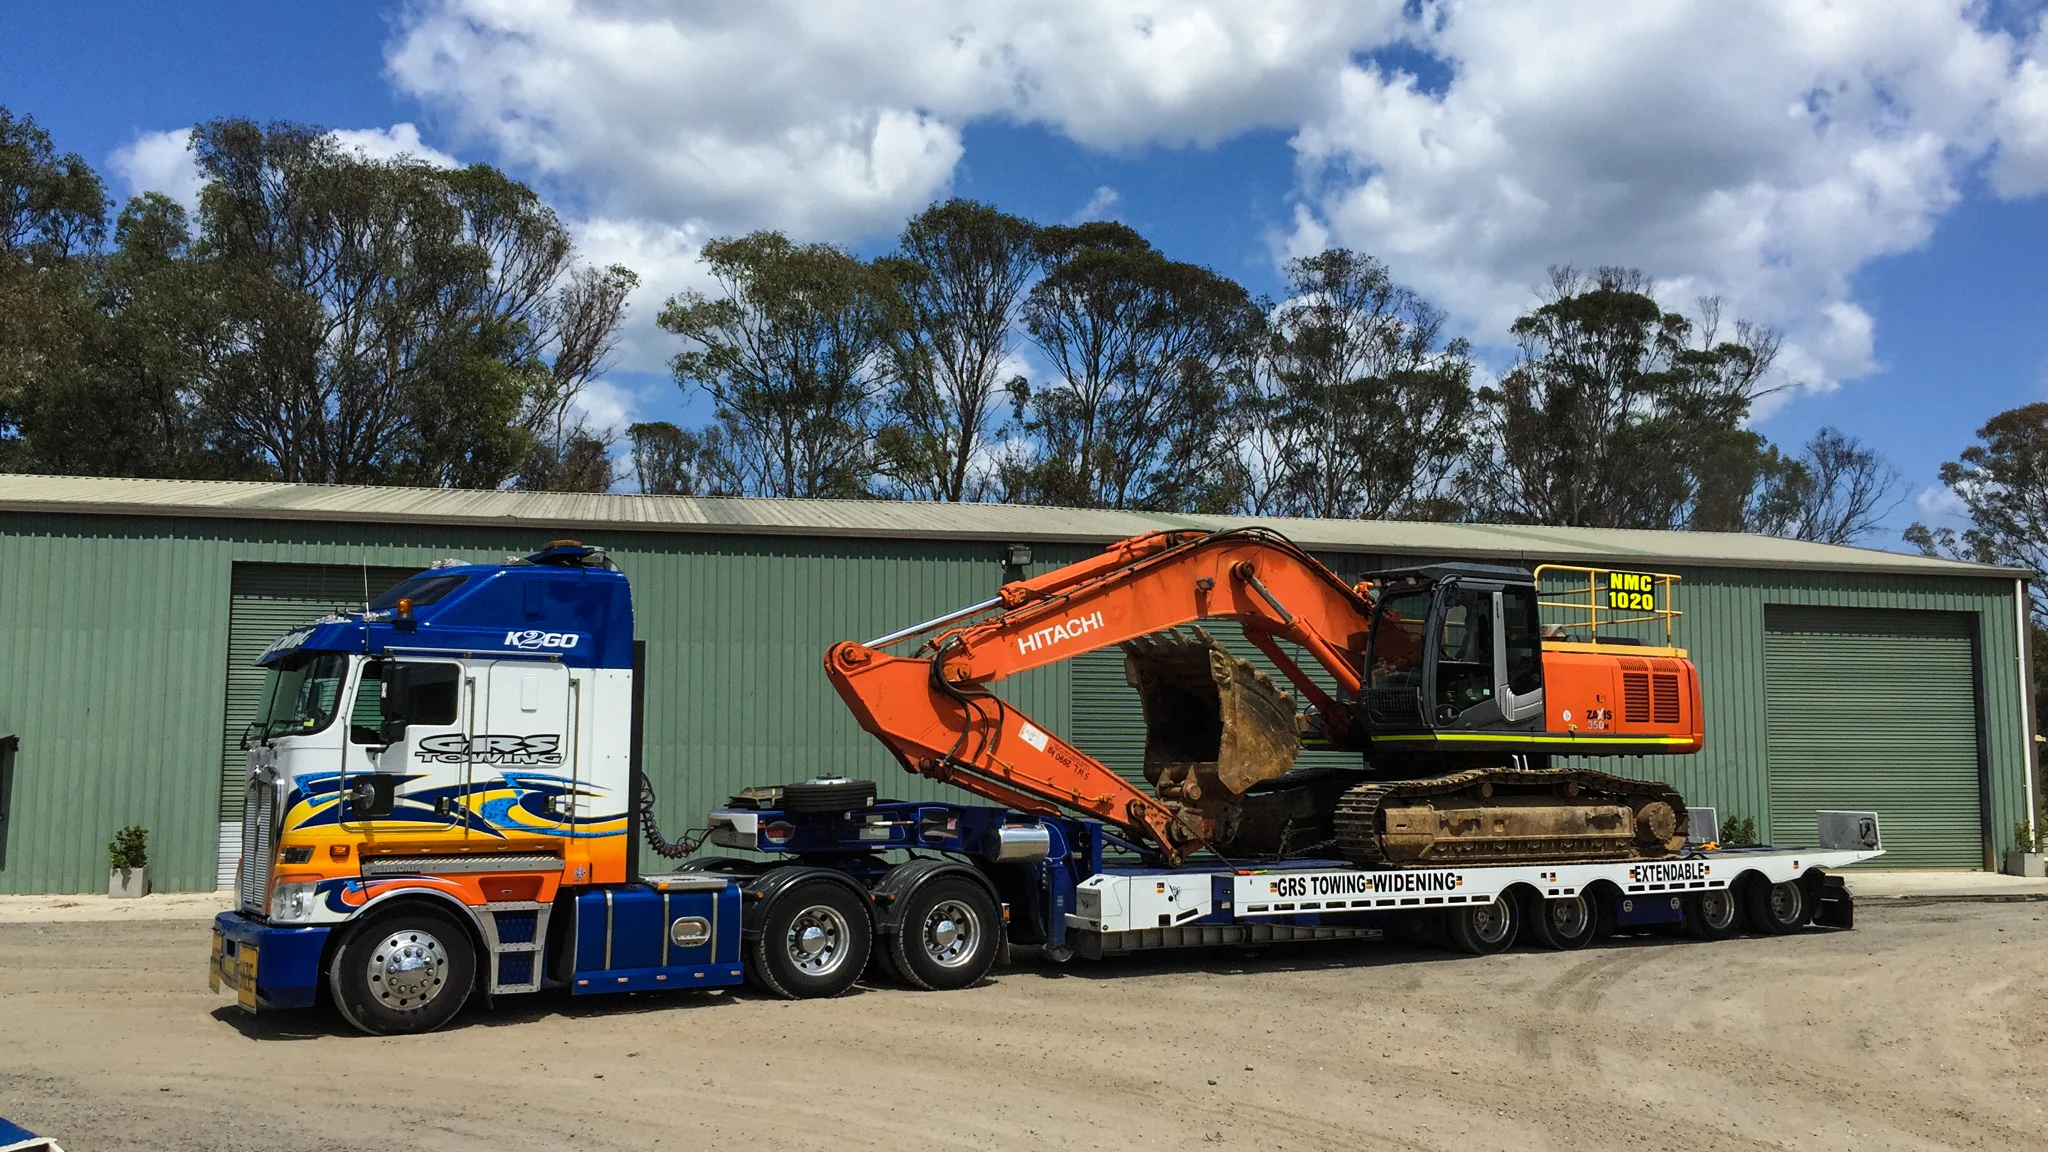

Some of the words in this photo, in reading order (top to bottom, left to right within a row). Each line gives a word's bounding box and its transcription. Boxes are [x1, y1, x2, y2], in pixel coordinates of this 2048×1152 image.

[1611, 573, 1652, 591] NMC
[1609, 591, 1654, 610] 1020
[504, 630, 579, 649] K2GO
[1017, 611, 1104, 655] HITACHI
[1586, 708, 1613, 720] ZAXIS
[419, 733, 561, 753] GRS
[415, 752, 563, 764] TOWING
[1634, 862, 1705, 883] EXTENDABLE
[1277, 876, 1307, 897] GRS
[1311, 874, 1366, 896] TOWING
[1373, 872, 1456, 893] WIDENING
